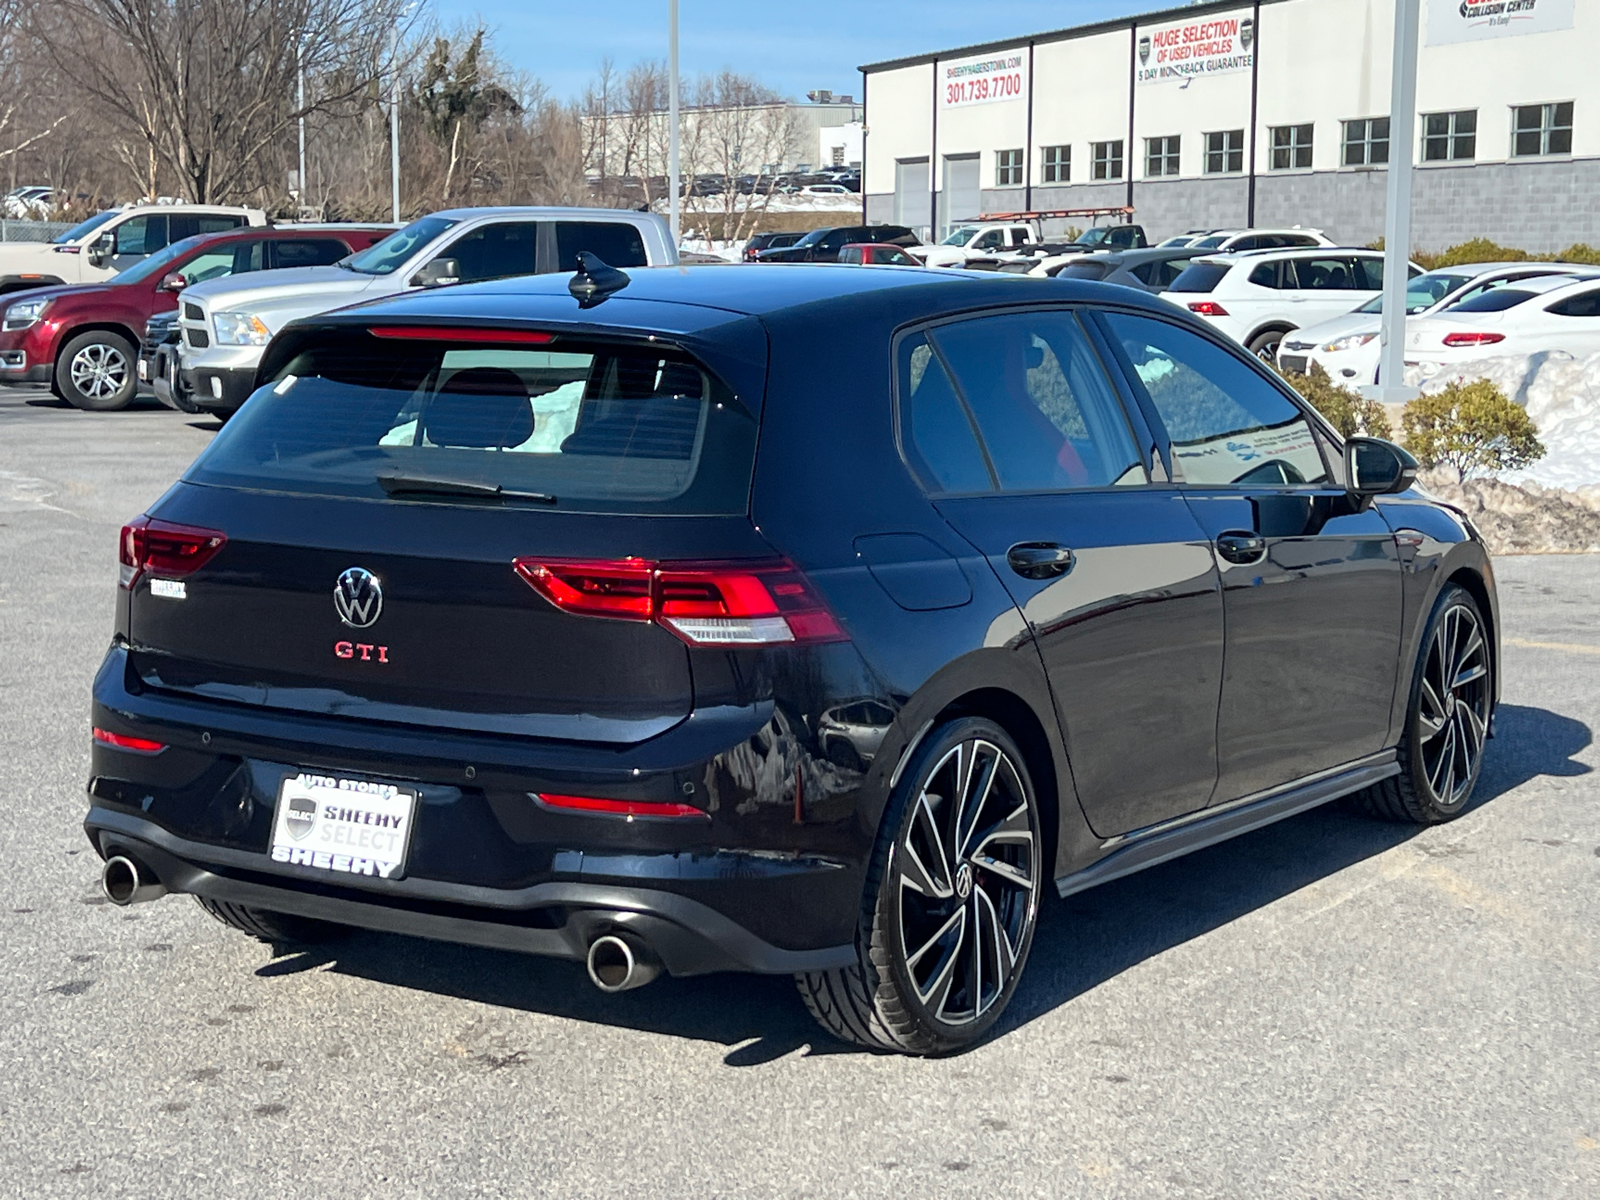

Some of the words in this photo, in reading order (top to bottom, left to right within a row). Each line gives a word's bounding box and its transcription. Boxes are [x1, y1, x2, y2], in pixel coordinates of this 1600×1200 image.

[1467, 2, 1506, 18] COLLISION
[1507, 0, 1537, 12] CENTER
[1153, 28, 1181, 49] HUGE
[1182, 19, 1238, 44] SELECTION
[1157, 49, 1168, 63] OF
[1169, 45, 1191, 61] USED
[1192, 39, 1232, 58] VEHICLES
[1139, 70, 1143, 81] 5
[1145, 67, 1158, 80] DAY
[1206, 54, 1252, 72] GUARANTEE
[946, 73, 1021, 104] 301.739.7700
[335, 641, 389, 663] GTI
[297, 773, 337, 788] AUTO
[339, 779, 398, 797] STORES
[324, 805, 403, 829] SHEEHY
[320, 823, 400, 852] SELECT
[271, 845, 401, 879] SHEEHY
